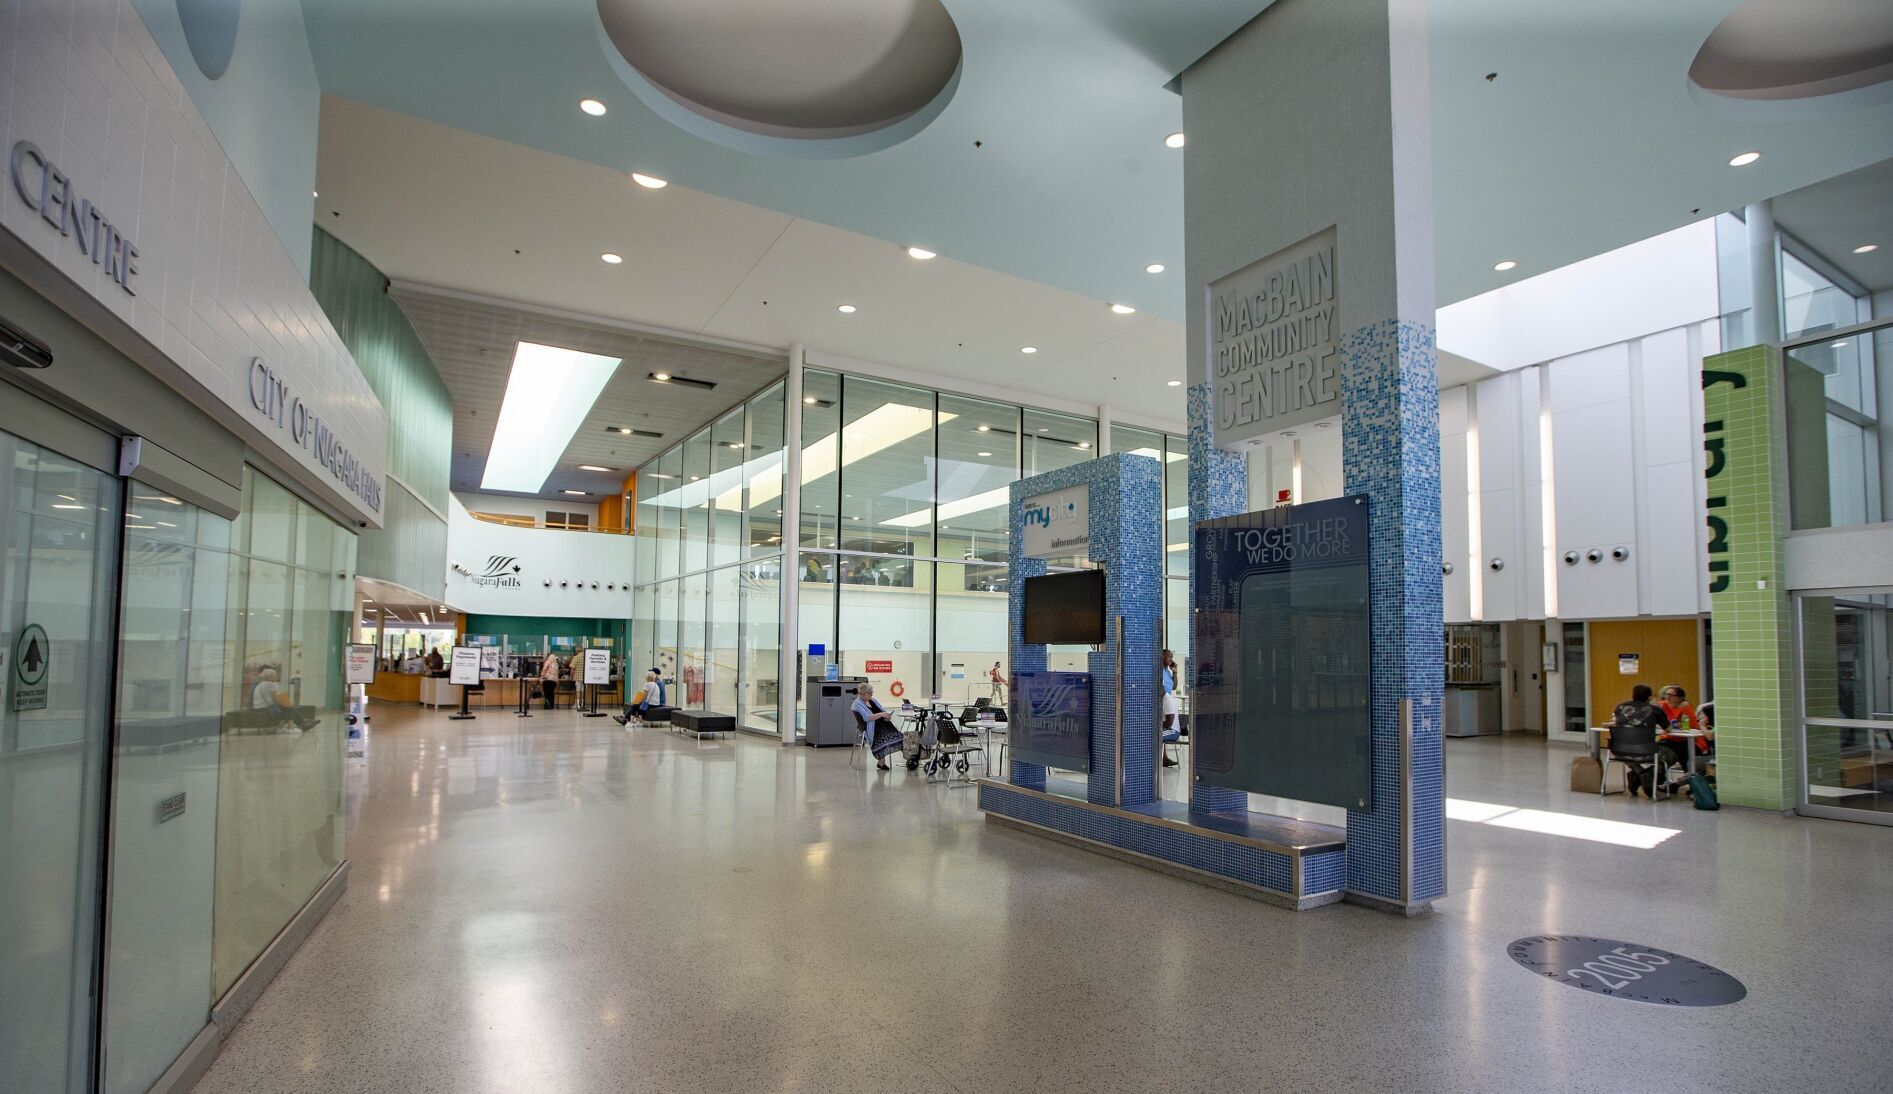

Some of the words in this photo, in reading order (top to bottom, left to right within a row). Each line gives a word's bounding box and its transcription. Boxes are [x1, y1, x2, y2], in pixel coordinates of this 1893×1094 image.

[11, 140, 140, 296] CENTRE
[1217, 305, 1334, 378] COMMUNITY
[1218, 345, 1337, 430] CENTRE
[249, 356, 288, 428] CITY
[292, 397, 313, 449] OF
[314, 417, 360, 495] NIAGARA
[361, 468, 381, 513] FALLS
[1234, 517, 1349, 552] TOGETHER
[1247, 548, 1269, 564] WE
[1273, 546, 1296, 562] DO
[1301, 540, 1351, 560] MORE
[1567, 947, 1671, 990] 2005
